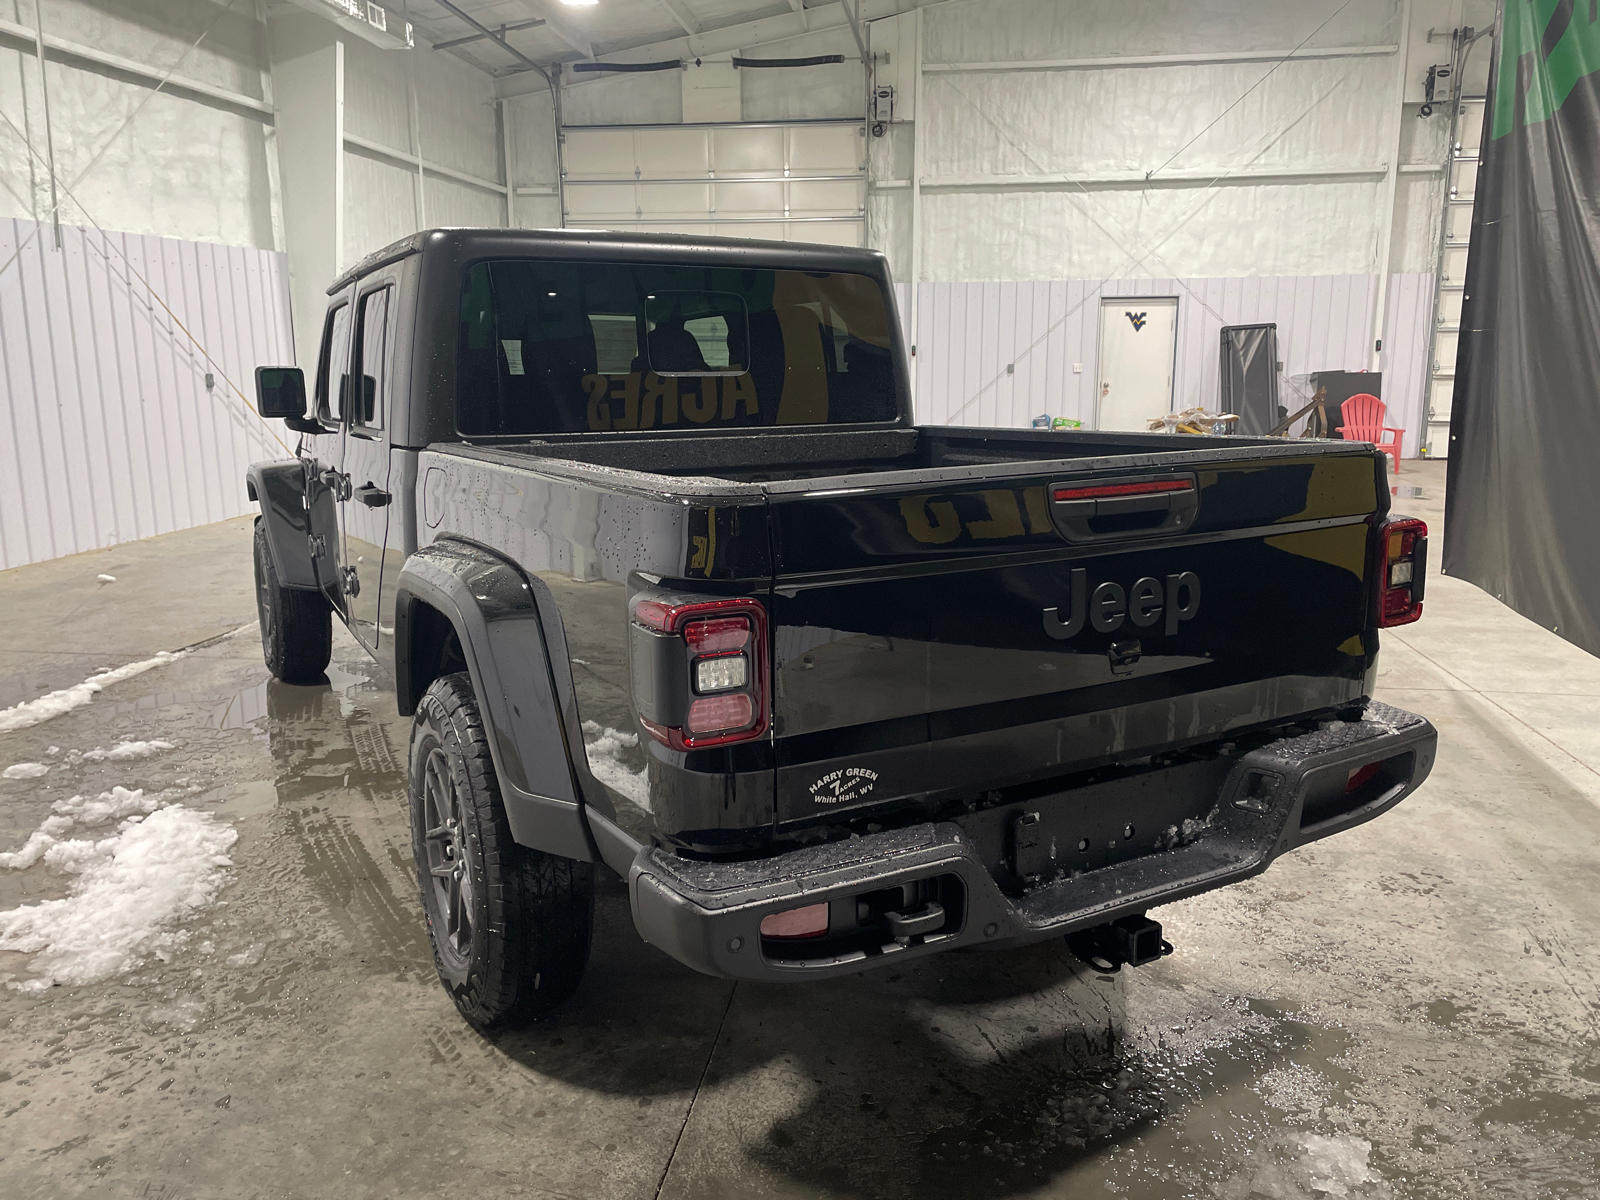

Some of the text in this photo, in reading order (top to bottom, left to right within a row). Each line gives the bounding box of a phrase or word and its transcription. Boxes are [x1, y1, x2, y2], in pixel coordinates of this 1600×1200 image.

[1042, 567, 1201, 640] Jeep
[809, 768, 878, 794] HARRY GREEN
[829, 777, 860, 796] 7 ACRES
[814, 783, 873, 804] White Hall, WV
